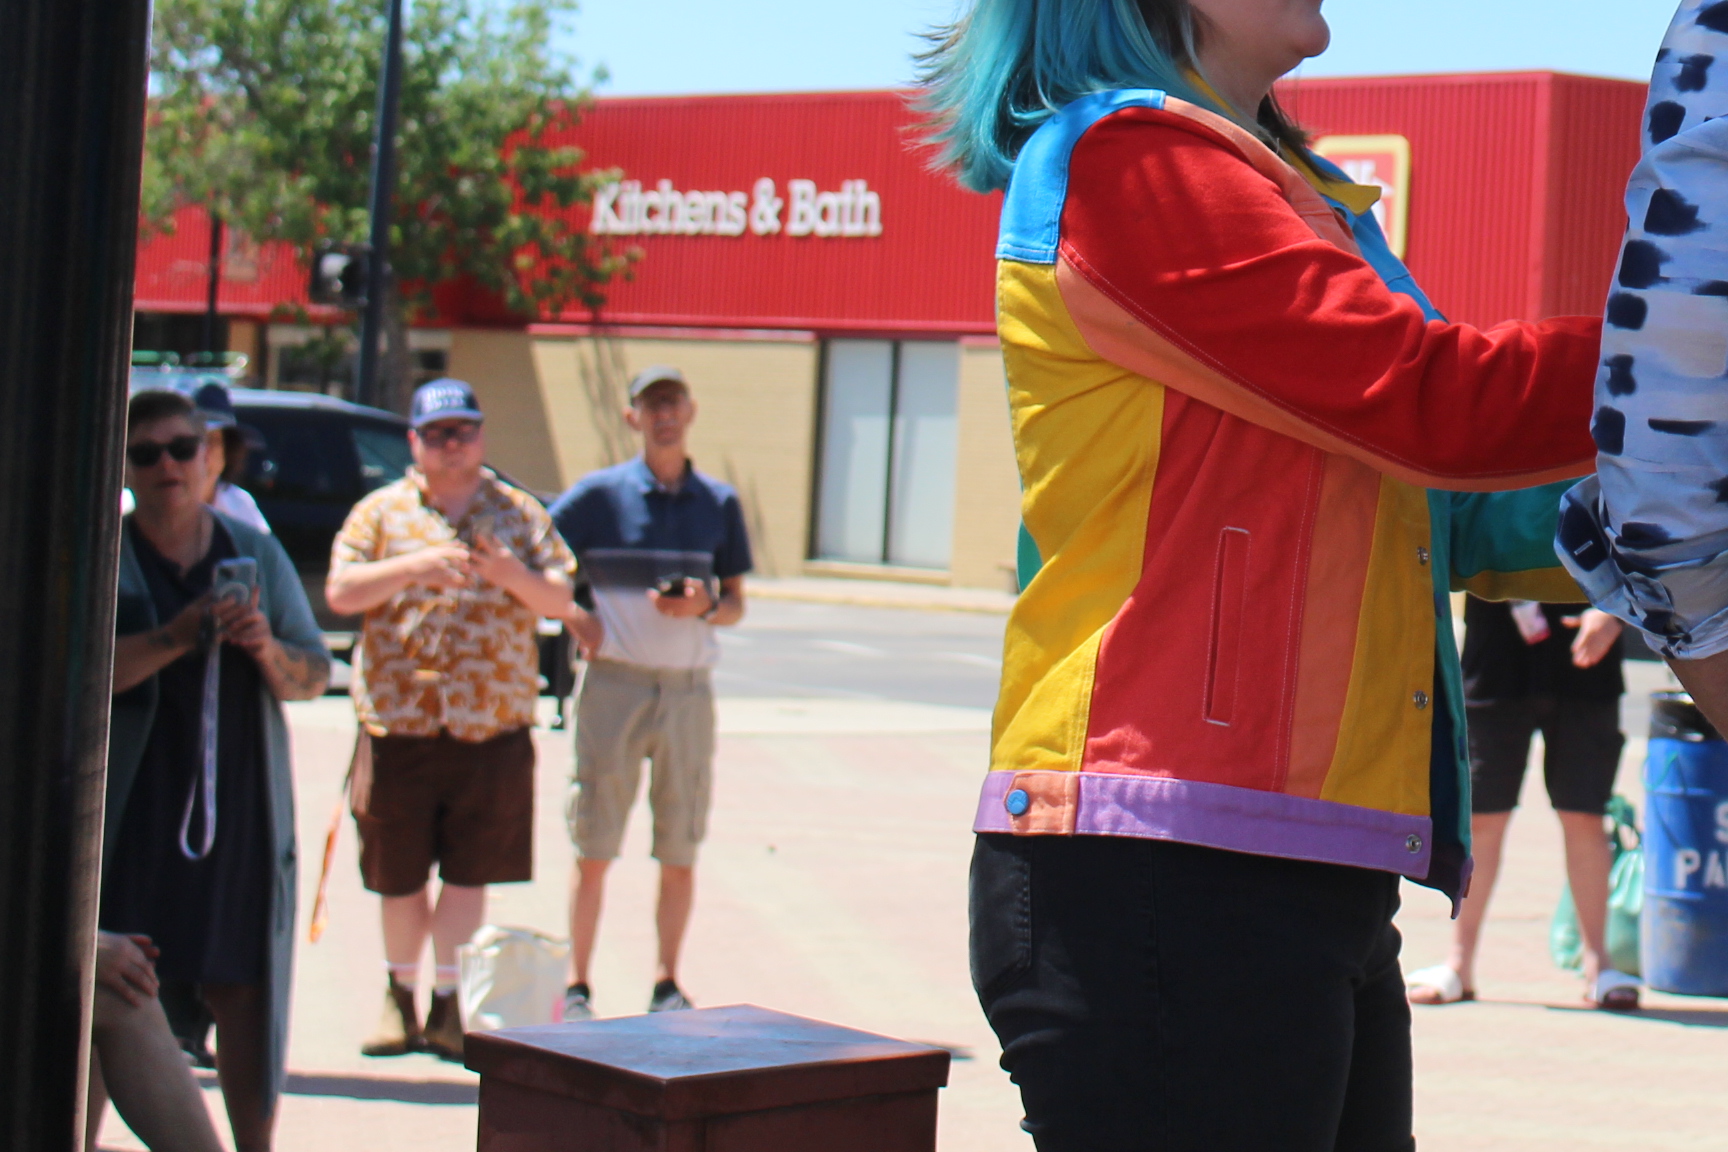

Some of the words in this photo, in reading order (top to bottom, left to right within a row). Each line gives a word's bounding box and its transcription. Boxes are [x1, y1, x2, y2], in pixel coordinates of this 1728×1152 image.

[590, 179, 748, 237] Kitchens
[751, 176, 783, 236] &
[786, 178, 882, 238] Bath
